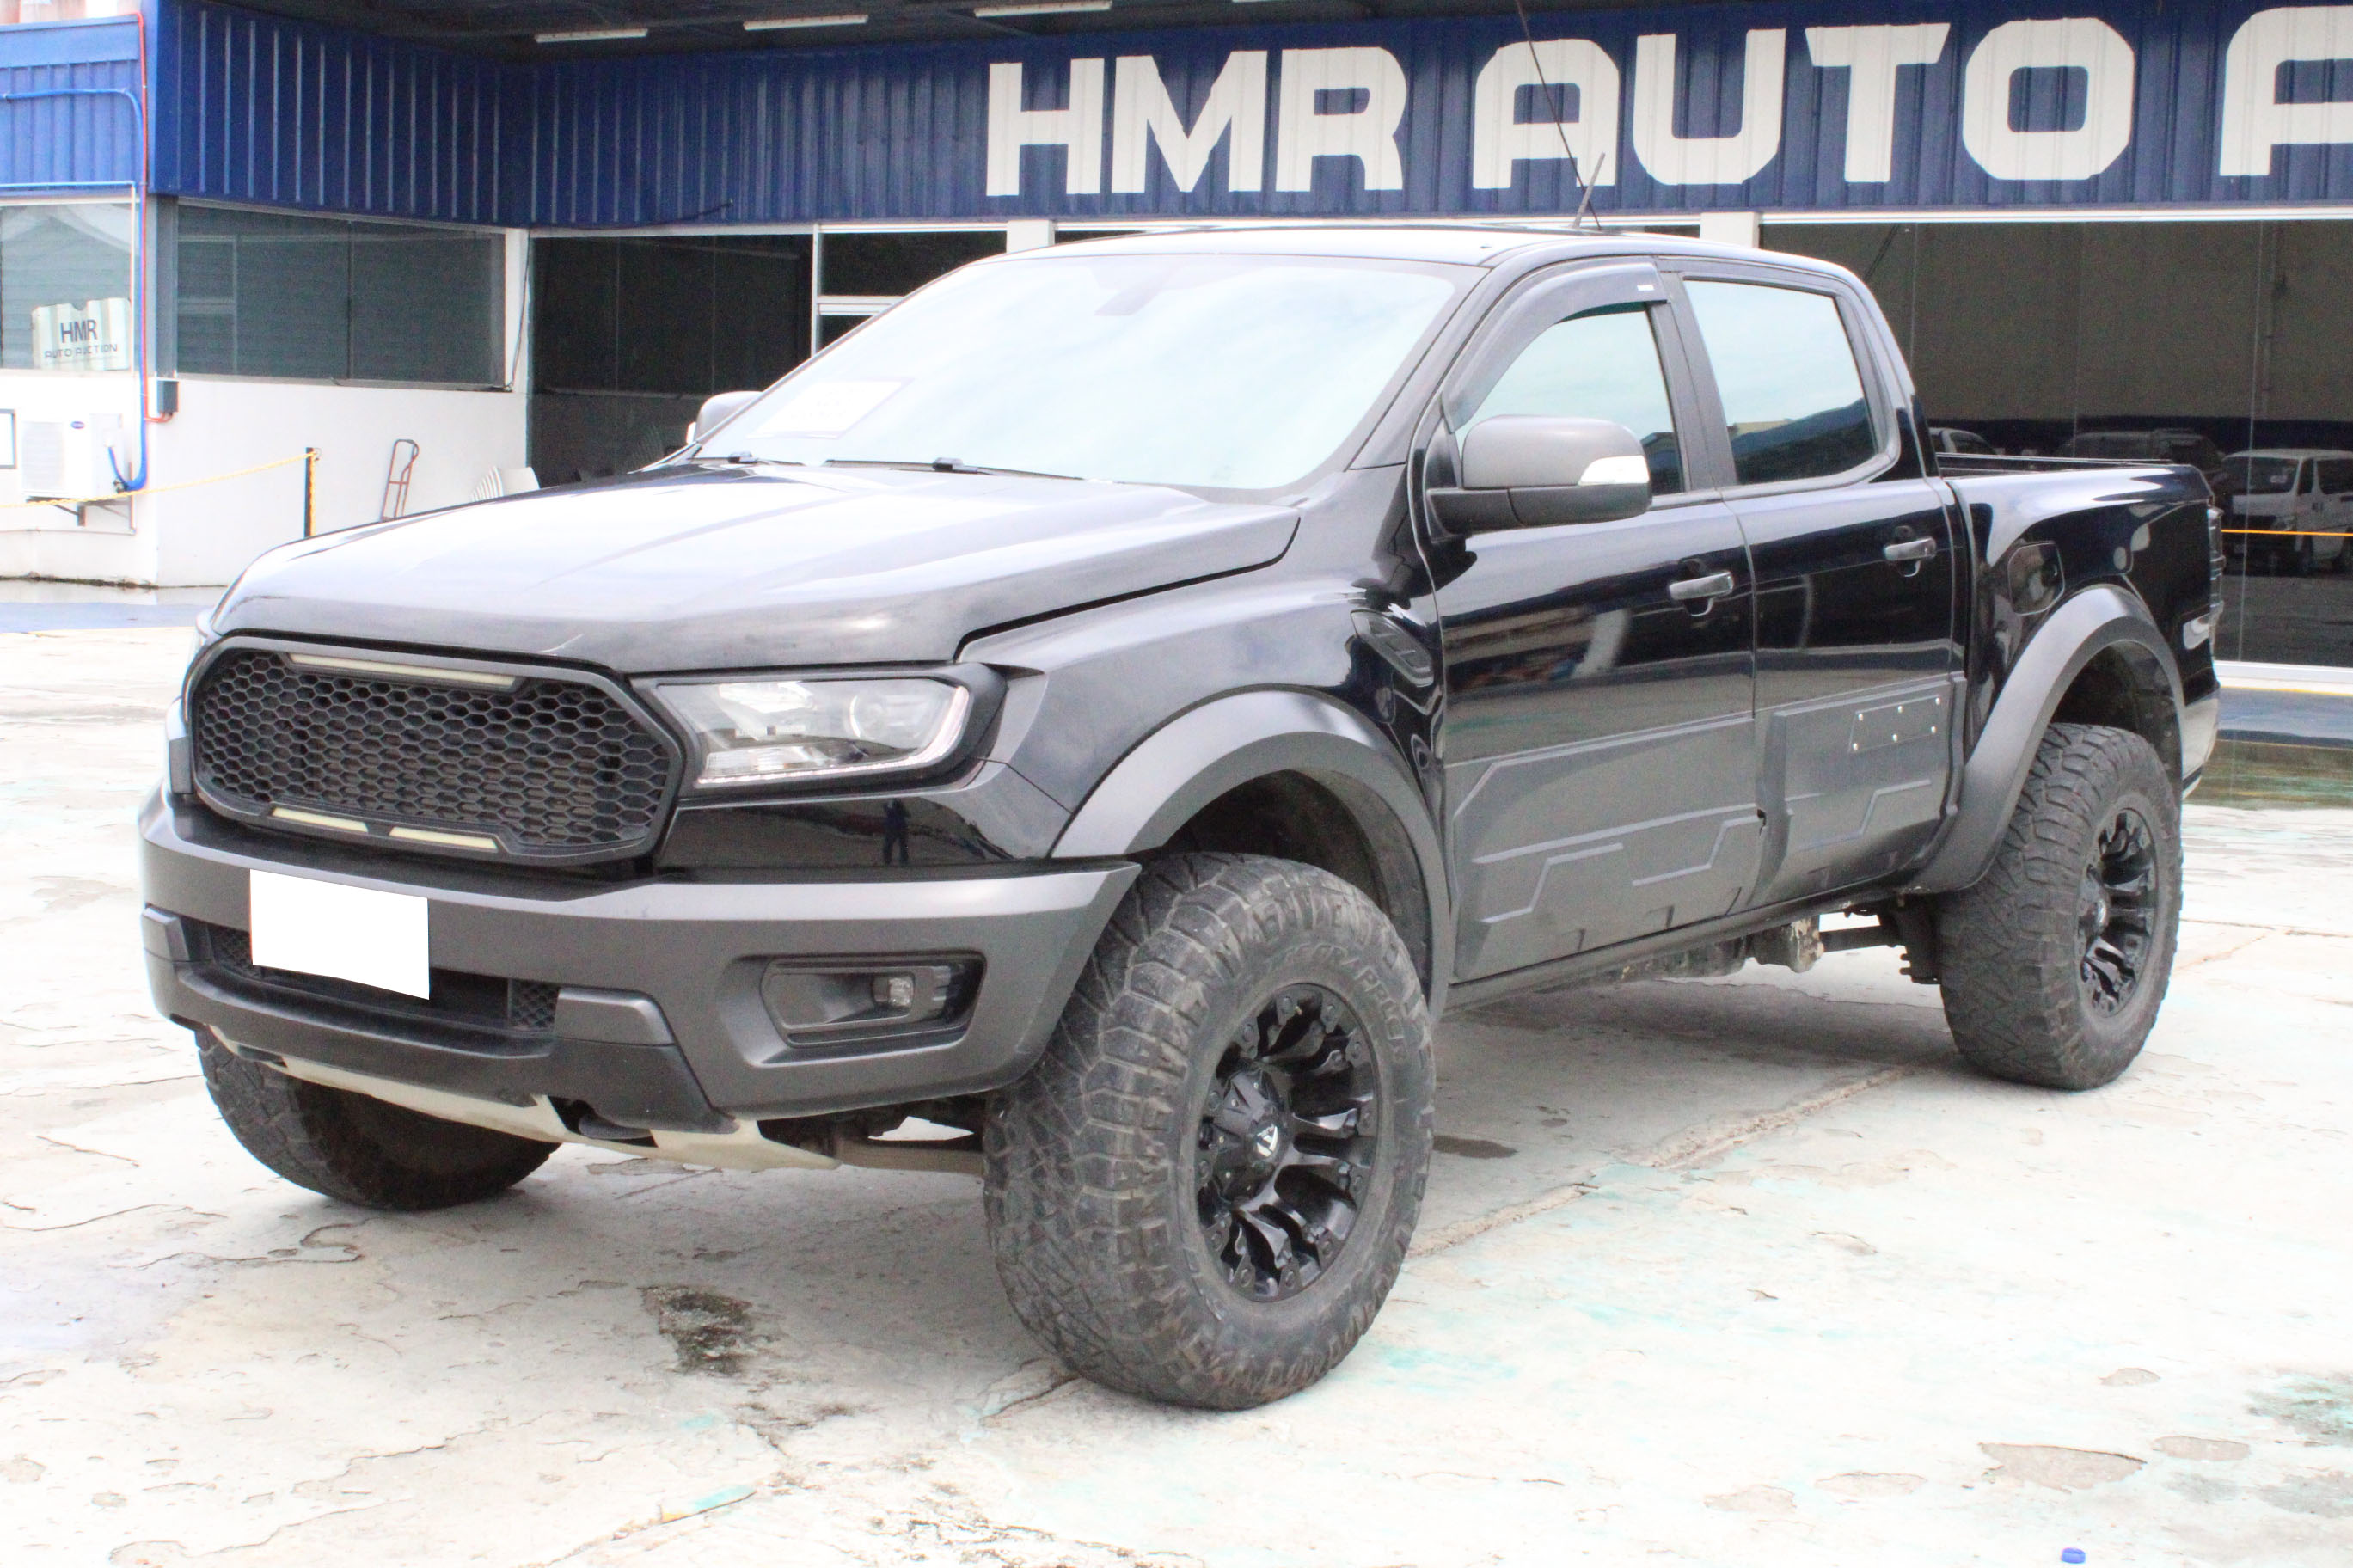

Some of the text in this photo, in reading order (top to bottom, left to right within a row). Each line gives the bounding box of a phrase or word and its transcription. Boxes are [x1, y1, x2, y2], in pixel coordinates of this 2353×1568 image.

[985, 46, 1407, 197] HMR
[1471, 17, 2135, 190] AUTO
[59, 319, 98, 343] HMR
[45, 348, 72, 358] AUTO
